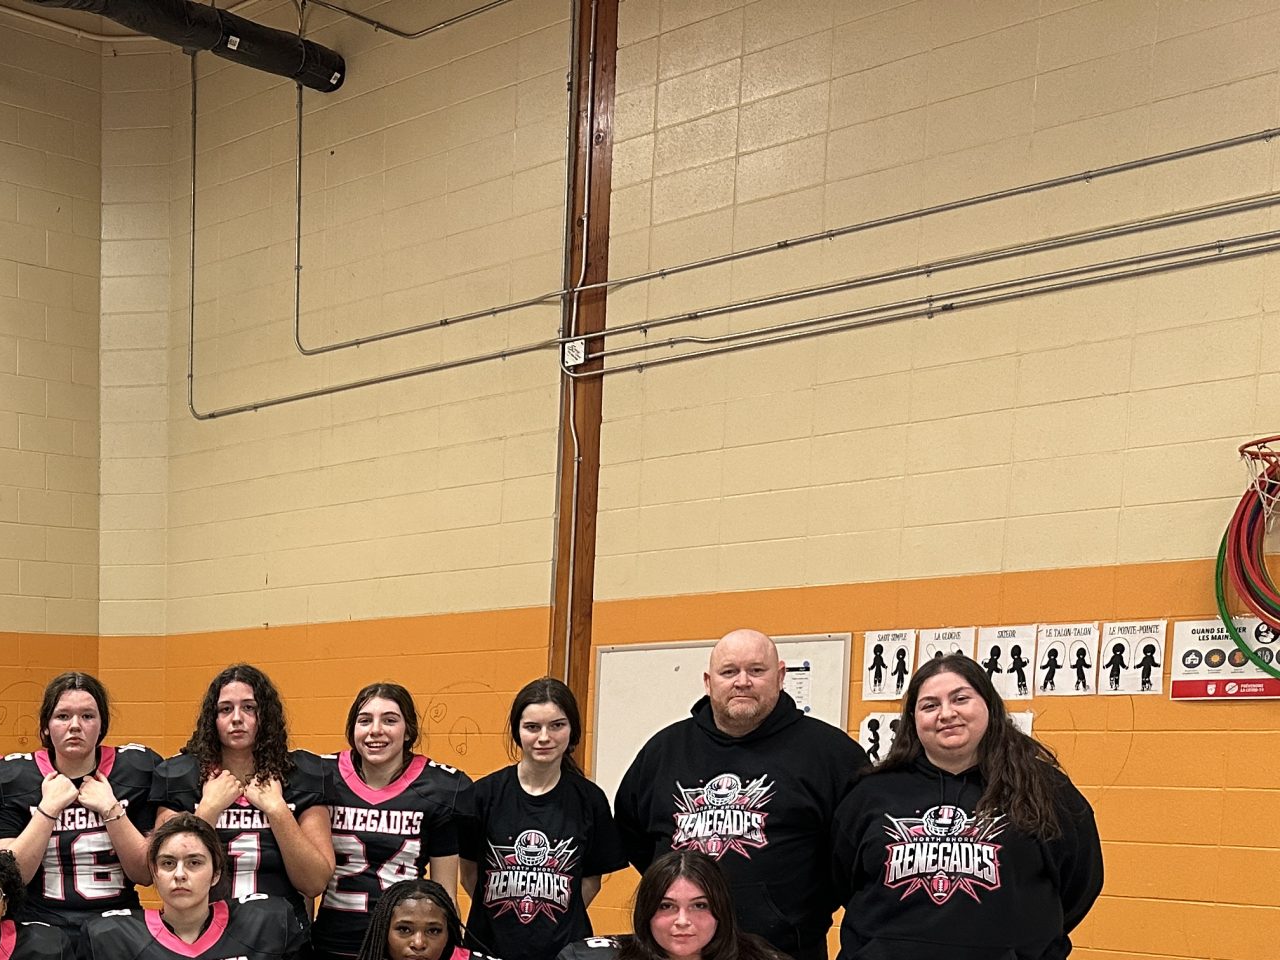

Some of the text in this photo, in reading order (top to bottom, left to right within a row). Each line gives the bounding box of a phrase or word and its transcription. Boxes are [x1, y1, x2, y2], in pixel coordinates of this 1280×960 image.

[1054, 627, 1092, 637] TALON-TALON
[676, 809, 763, 844] RENEGADES
[43, 831, 125, 900] 16
[228, 832, 262, 899] 1
[322, 832, 422, 913] 24
[888, 842, 997, 884] RENEGADES
[486, 871, 570, 909] RENEGADES
